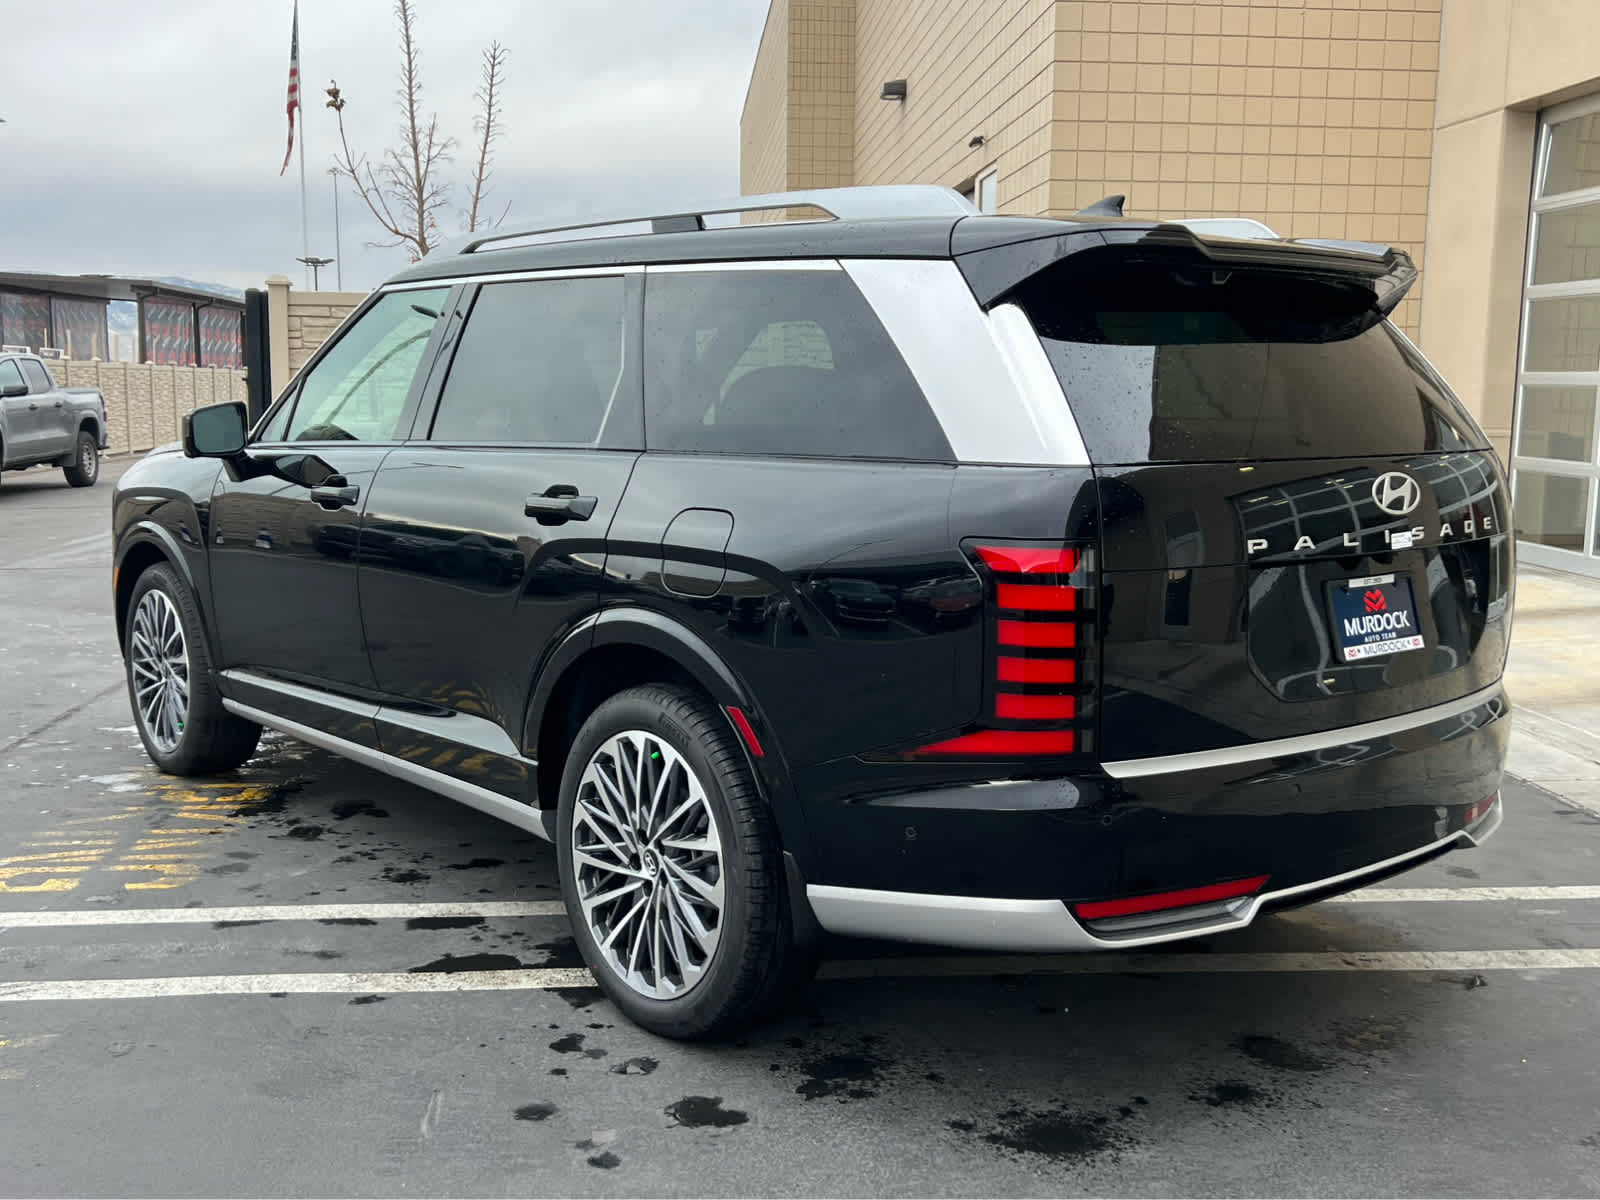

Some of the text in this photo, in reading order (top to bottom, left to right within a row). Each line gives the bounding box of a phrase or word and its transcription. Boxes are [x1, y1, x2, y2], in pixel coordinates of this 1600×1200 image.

[1247, 516, 1493, 554] PALISADE
[1343, 609, 1411, 637] MURDOCK
[1363, 639, 1408, 656] MURDOCK
[1364, 633, 1381, 643] AUTO
